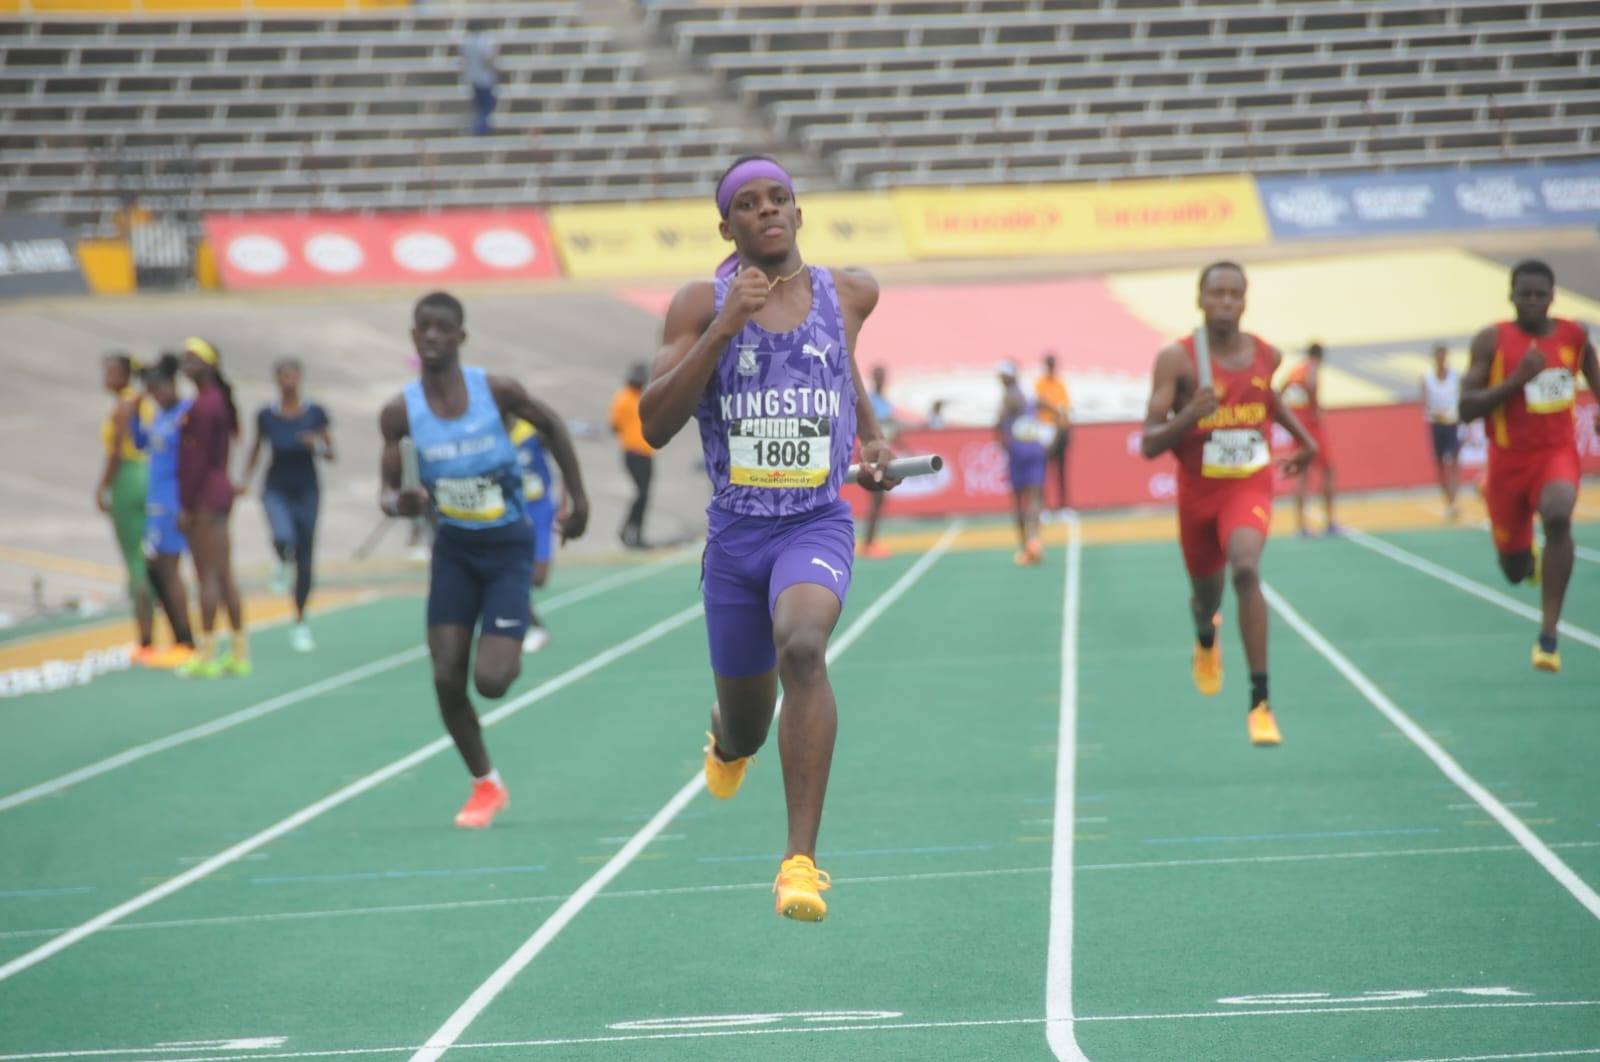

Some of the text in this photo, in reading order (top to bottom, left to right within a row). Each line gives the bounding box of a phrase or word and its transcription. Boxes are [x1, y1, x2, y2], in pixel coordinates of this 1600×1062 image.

[720, 388, 840, 420] KINGSTON
[740, 418, 800, 438] PUMA
[753, 440, 810, 467] 1808
[749, 474, 811, 485] GraceKennedy
